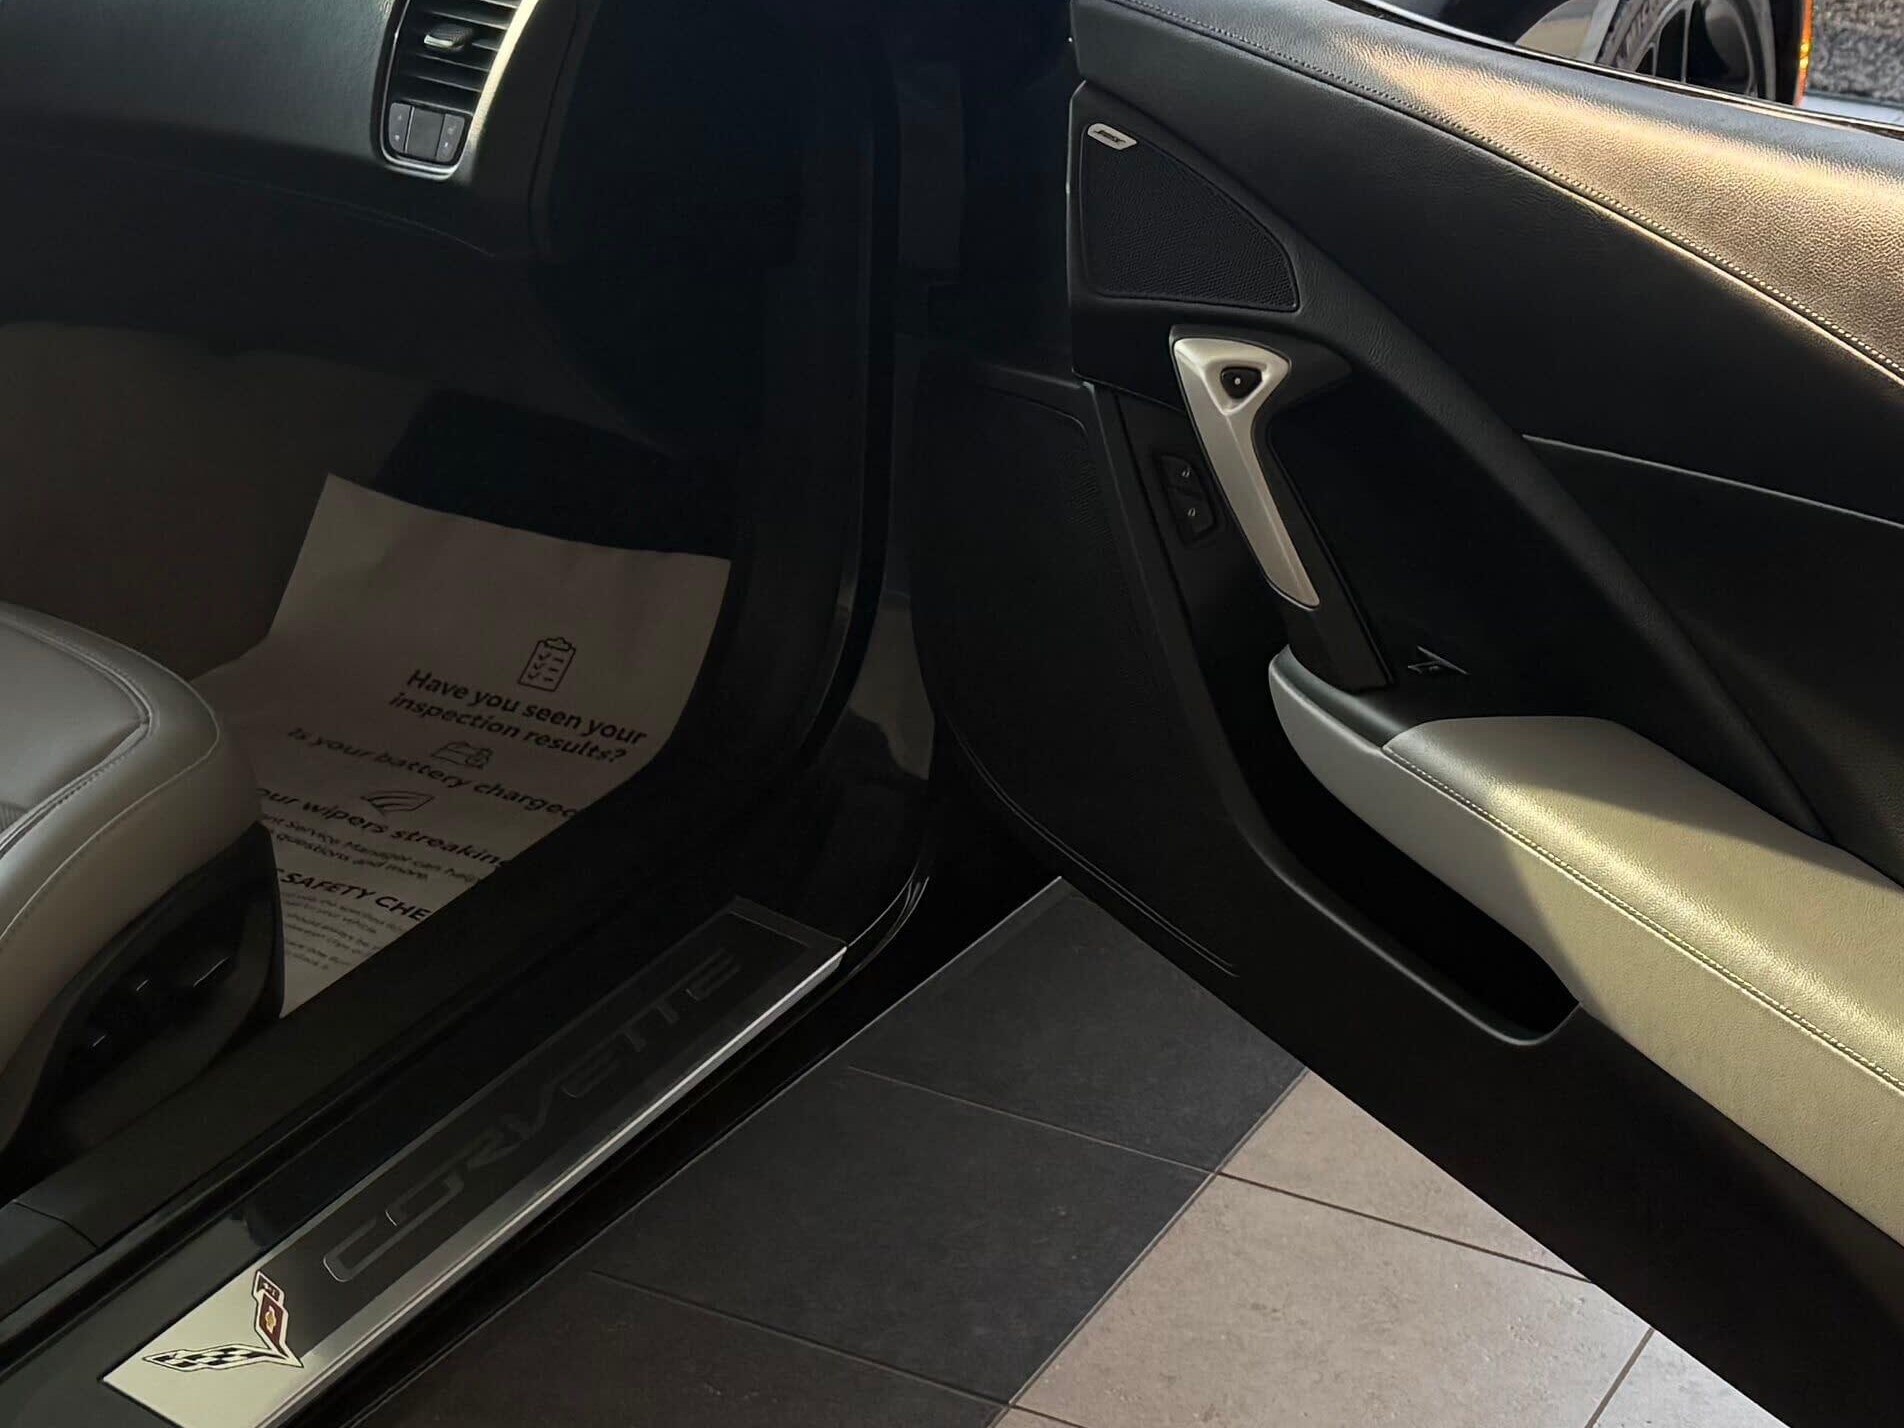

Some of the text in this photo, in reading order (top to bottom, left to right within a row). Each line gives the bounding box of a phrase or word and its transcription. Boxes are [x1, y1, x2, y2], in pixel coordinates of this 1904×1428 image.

[387, 691, 628, 764] inspection results?
[406, 668, 648, 746] Have you seen your
[311, 733, 371, 758] your
[372, 750, 475, 789] battery
[301, 800, 390, 834] wipers
[280, 872, 378, 901] SAFETY
[322, 945, 742, 1283] CORVETTE
